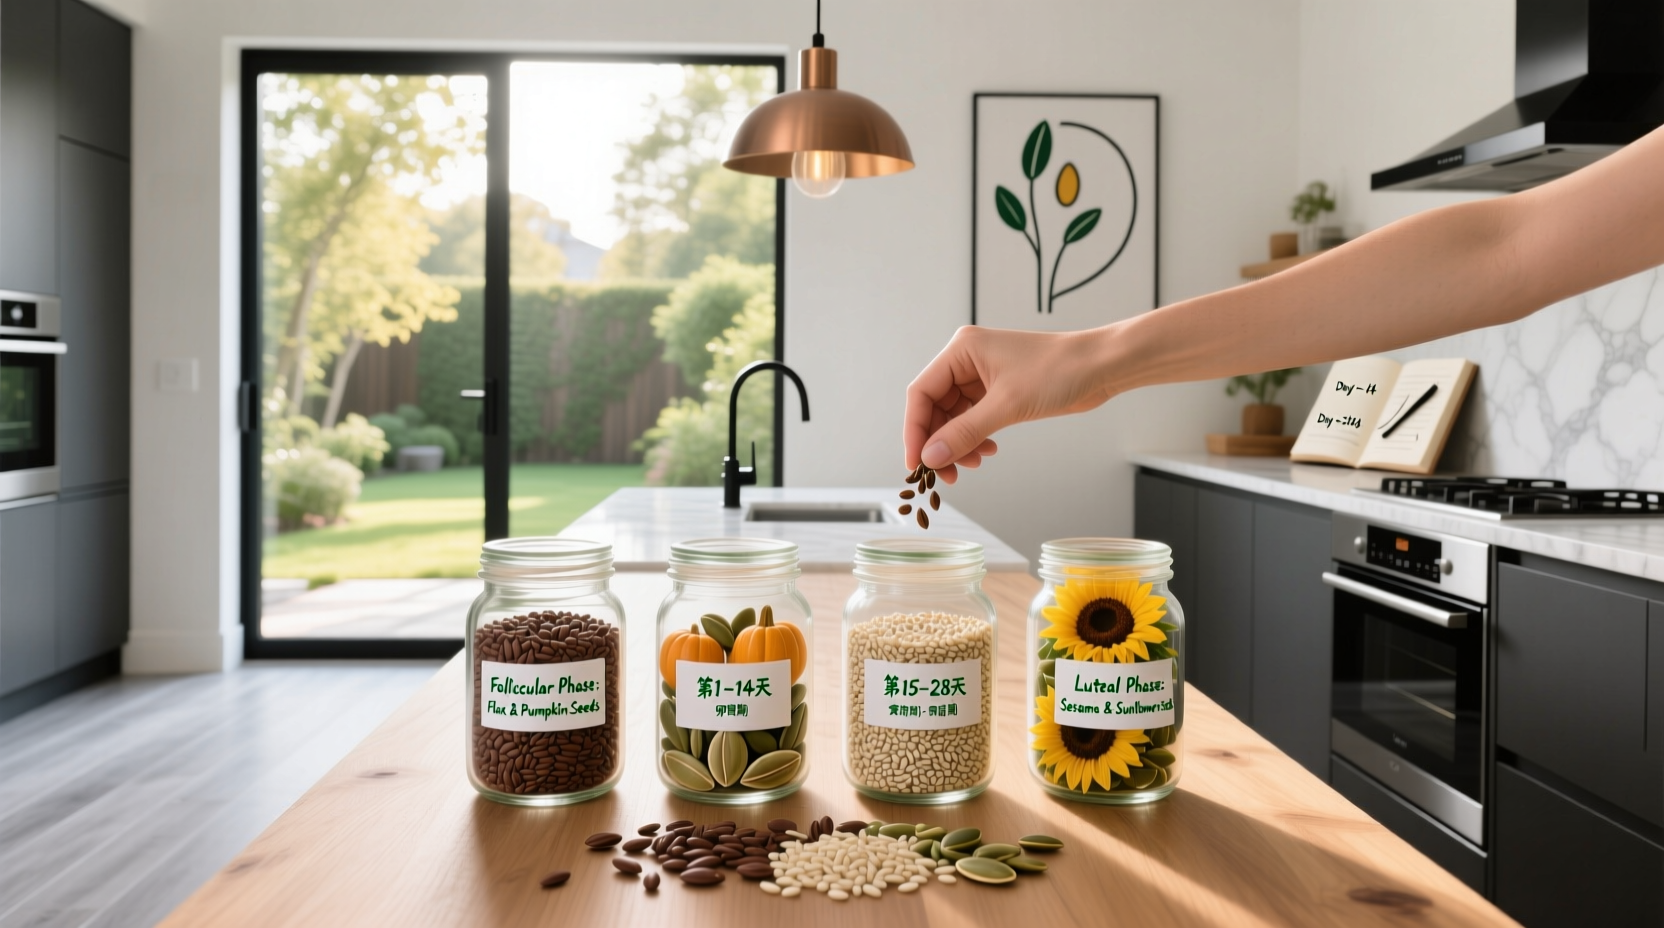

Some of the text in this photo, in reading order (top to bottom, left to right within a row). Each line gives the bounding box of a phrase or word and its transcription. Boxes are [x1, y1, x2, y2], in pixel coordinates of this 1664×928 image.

[1335, 380, 1355, 396] Day
[509, 702, 518, 716] &
[520, 702, 568, 721] Pumpkin
[569, 699, 600, 714] Seeds
[1103, 701, 1112, 714] &
